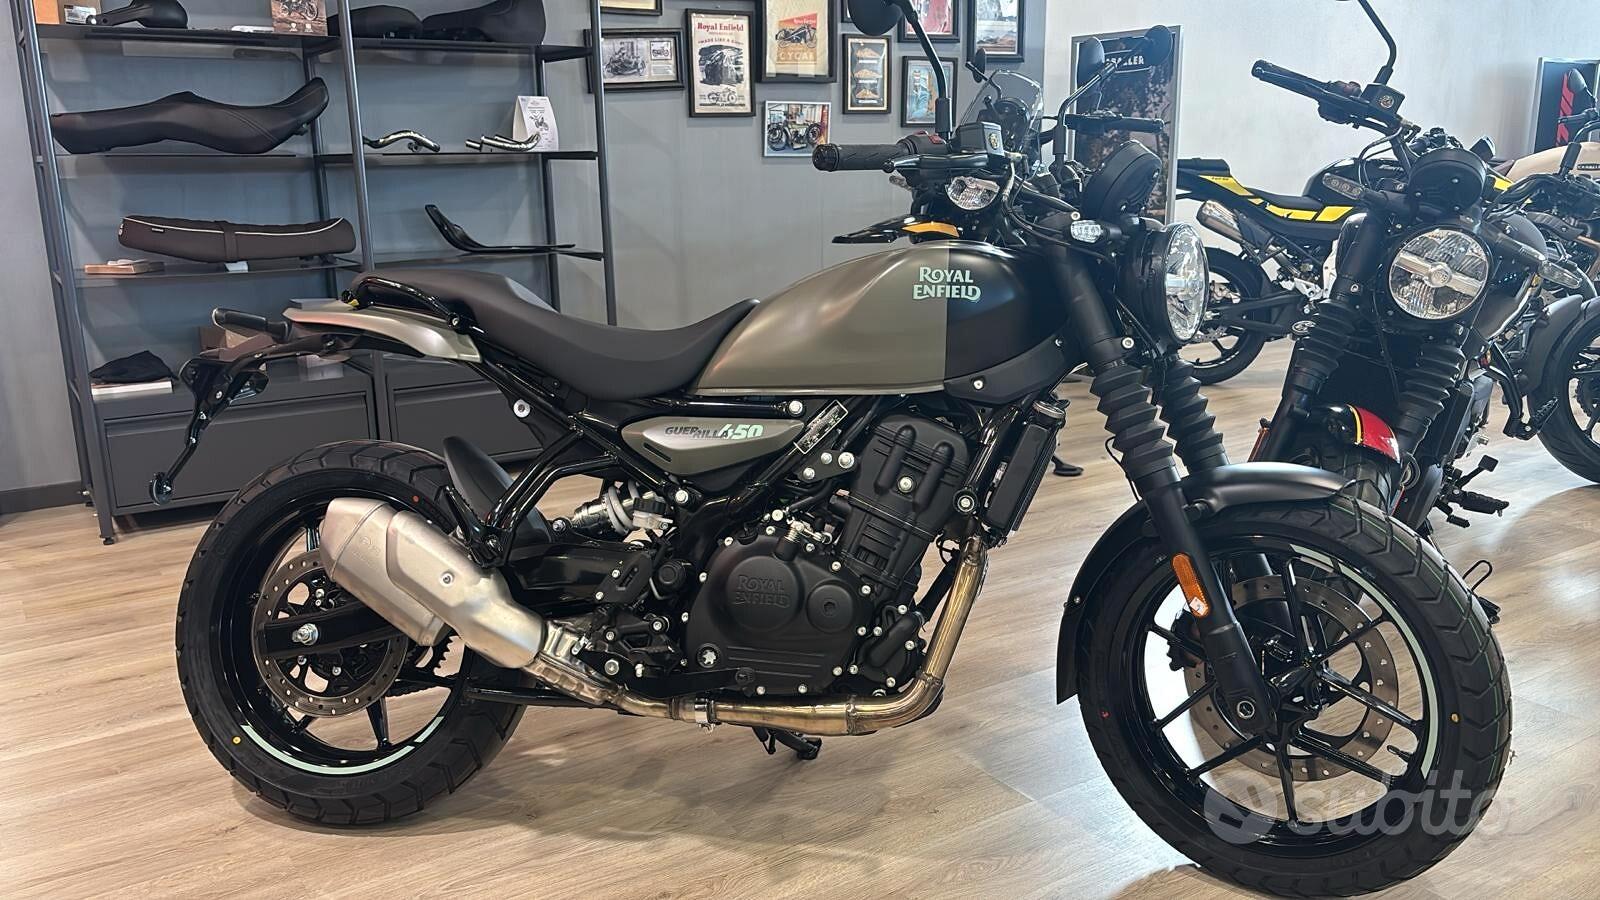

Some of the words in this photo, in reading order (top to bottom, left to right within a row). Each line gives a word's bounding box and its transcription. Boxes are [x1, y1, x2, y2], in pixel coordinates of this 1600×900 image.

[697, 22, 718, 32] Royal
[719, 23, 744, 32] Enfield
[919, 266, 974, 284] ROYAL
[913, 284, 981, 303] ENFIELD
[719, 423, 764, 440] 450
[738, 574, 784, 592] ROYAL
[735, 591, 791, 608] ENFIELD
